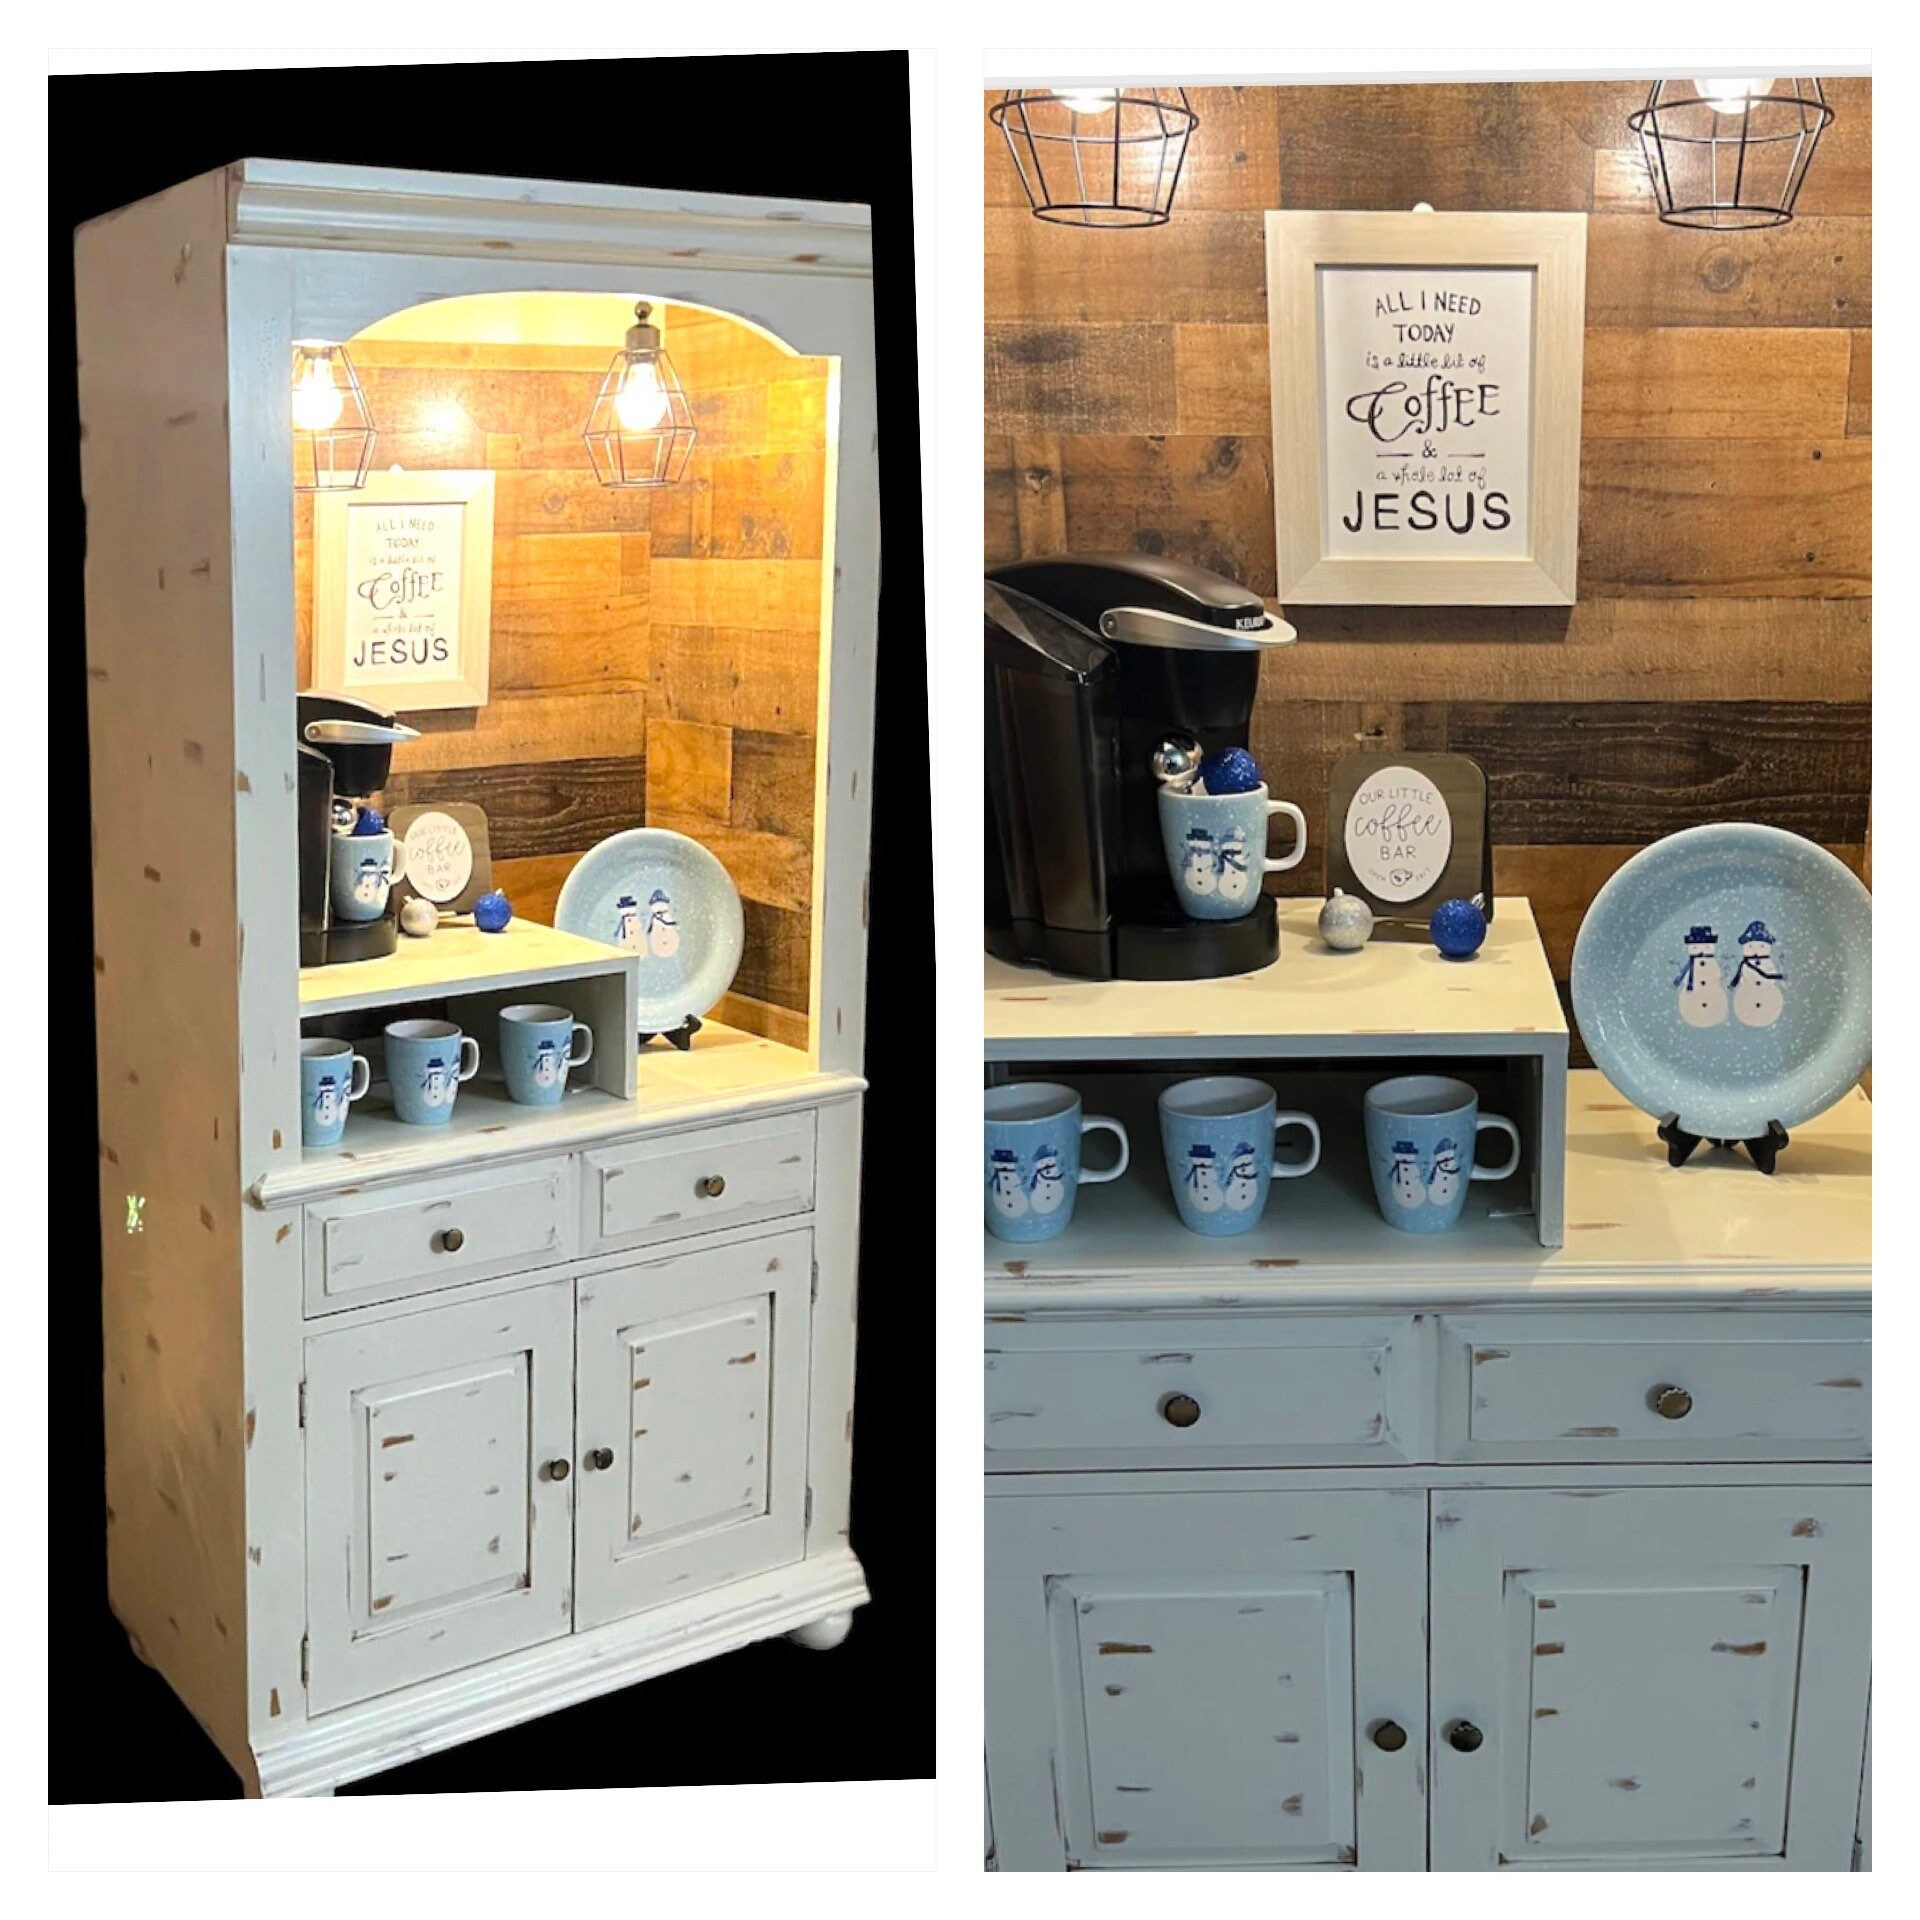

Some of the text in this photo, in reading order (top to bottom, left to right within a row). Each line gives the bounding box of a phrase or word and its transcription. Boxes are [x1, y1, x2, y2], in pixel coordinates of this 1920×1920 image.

[1375, 290, 1482, 317] ALL I NEED
[1392, 323, 1455, 344] TODAY
[1365, 351, 1487, 374] is a little bit of
[1421, 439, 1439, 459] &
[1375, 462, 1487, 491] a whole lot of
[1343, 490, 1512, 535] JESUS
[375, 518, 396, 534] ALL
[352, 636, 450, 668] JESUS
[1359, 786, 1434, 806] OUR LITTLE
[1354, 803, 1442, 842] coffee
[408, 835, 466, 862] coffee
[1379, 845, 1417, 861] BAR
[427, 861, 451, 875] BAR
